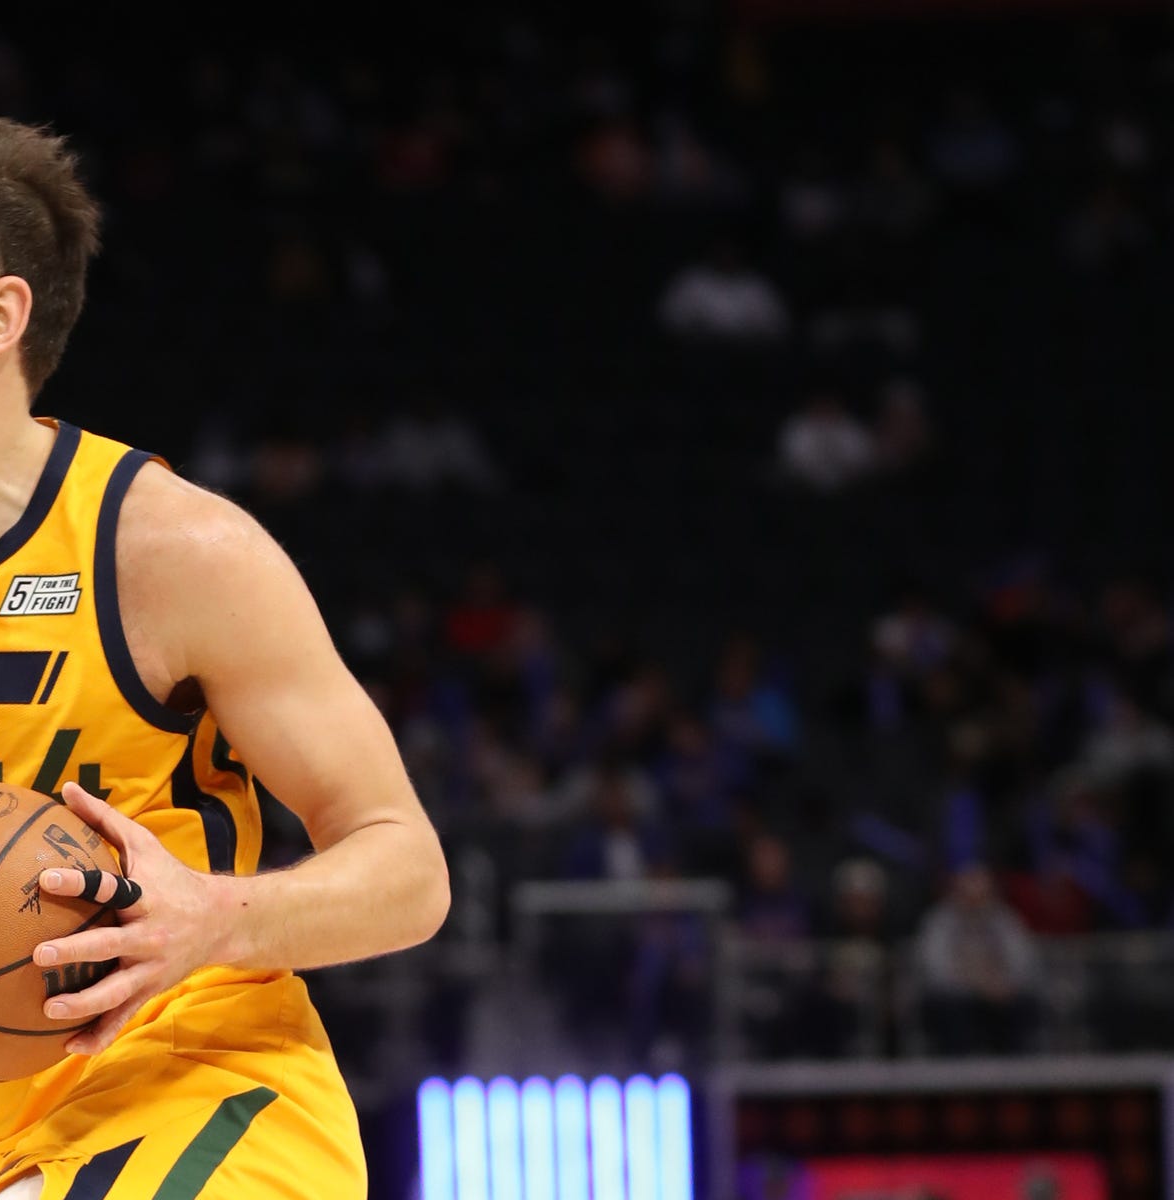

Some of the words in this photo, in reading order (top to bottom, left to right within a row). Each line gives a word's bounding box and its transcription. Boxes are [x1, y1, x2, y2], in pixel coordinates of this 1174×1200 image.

[41, 580, 58, 589] FOR
[59, 578, 75, 588] THE
[7, 581, 32, 611] 5
[31, 595, 75, 610] FIGHT
